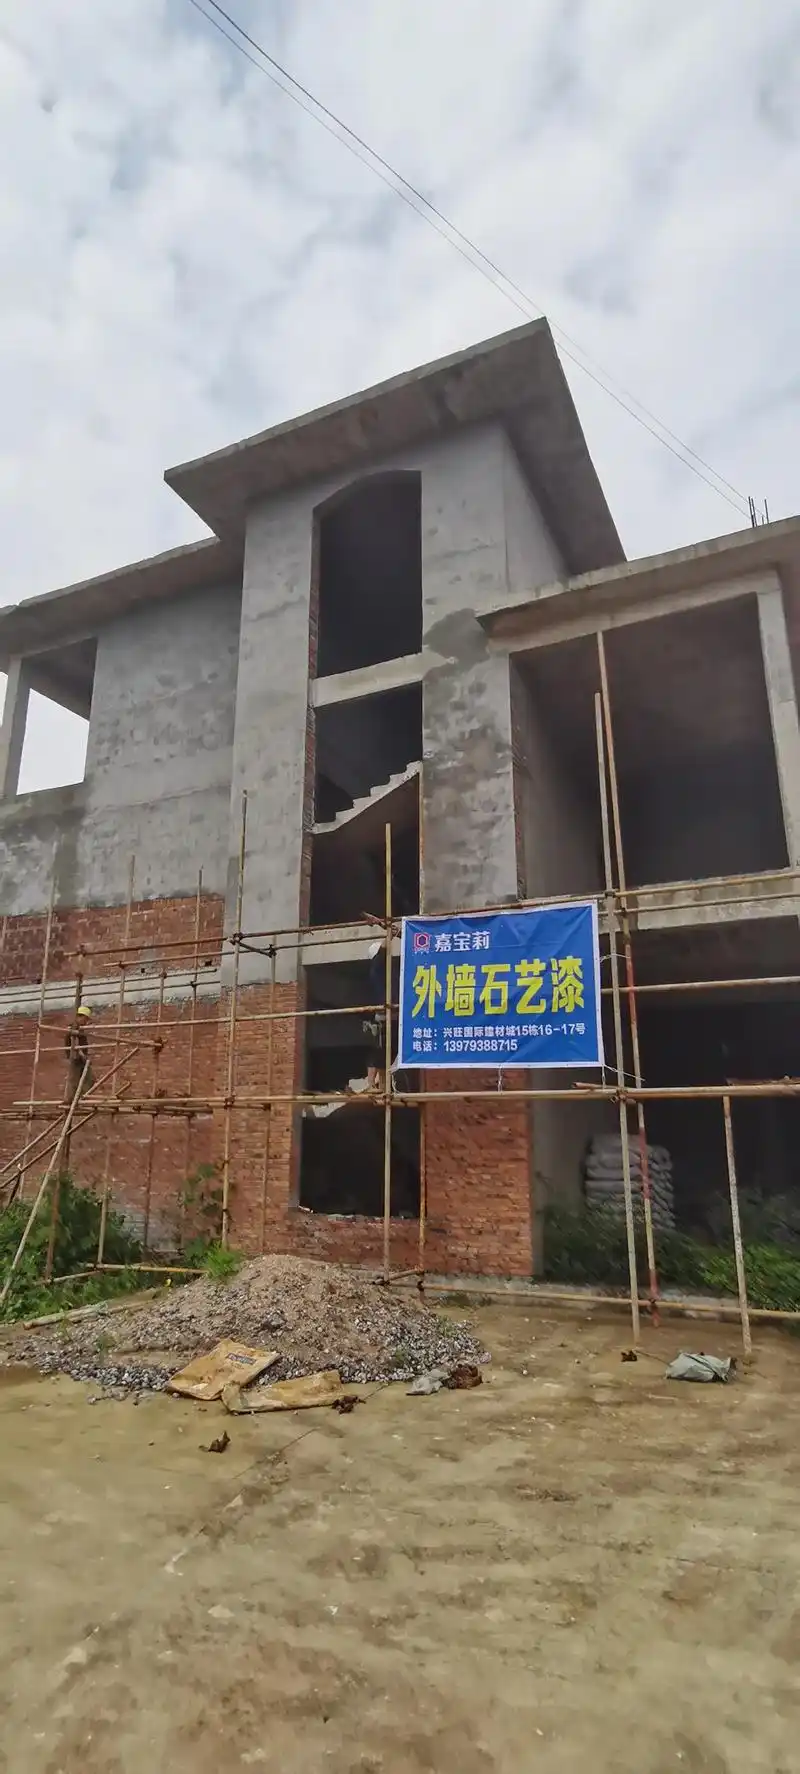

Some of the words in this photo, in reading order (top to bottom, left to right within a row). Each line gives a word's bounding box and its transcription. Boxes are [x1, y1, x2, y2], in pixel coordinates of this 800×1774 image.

[434, 930, 490, 952] 嘉宝莉
[411, 956, 585, 1018] 外墙石艺漆
